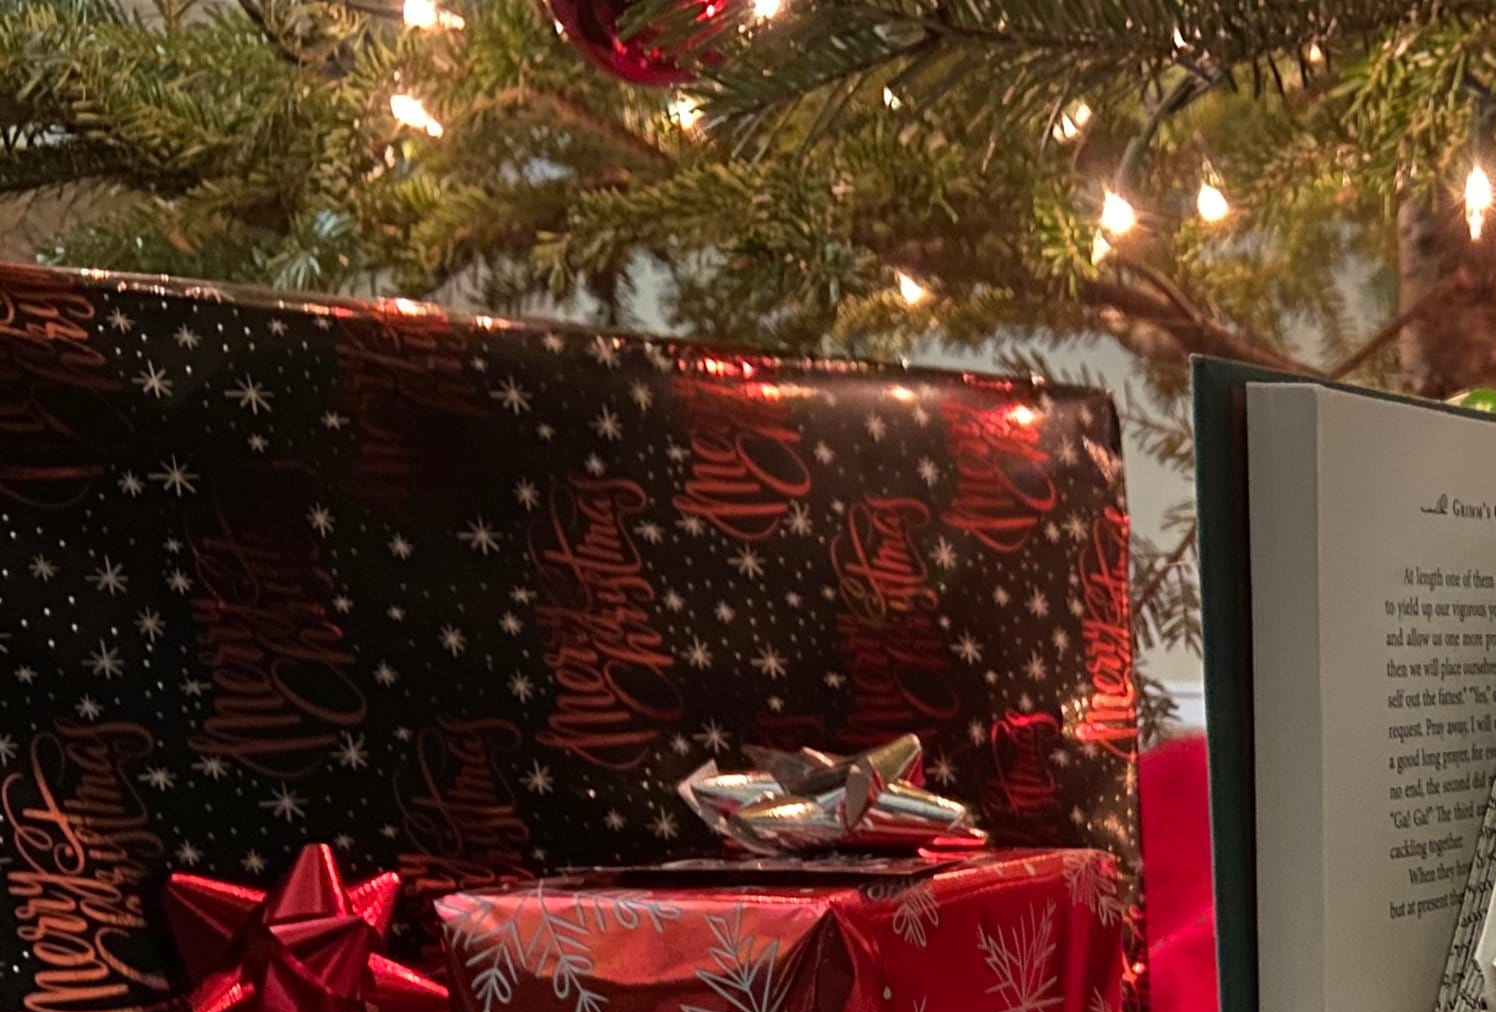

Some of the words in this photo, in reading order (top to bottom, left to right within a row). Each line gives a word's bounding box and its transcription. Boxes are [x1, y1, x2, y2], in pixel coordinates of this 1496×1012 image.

[1416, 566, 1443, 591] length
[1473, 569, 1495, 589] them
[1385, 600, 1396, 616] to
[1397, 597, 1419, 621] yield
[1421, 603, 1433, 621] up
[1435, 603, 1450, 616] our
[1386, 627, 1404, 647] and
[1406, 627, 1429, 647] allow
[1432, 633, 1443, 646] us
[1444, 633, 1460, 646] one
[1462, 633, 1483, 647] more
[1386, 659, 1408, 678] then
[1409, 664, 1422, 677] we
[1422, 657, 1439, 676] will
[1440, 658, 1462, 681] place
[1388, 689, 1404, 709] self
[1405, 692, 1421, 708] out
[1422, 689, 1436, 707] the
[1389, 756, 1395, 770] a
[1396, 748, 1420, 775] good
[1421, 748, 1441, 771] long
[1390, 786, 1402, 800] no
[1426, 776, 1441, 796] the
[1442, 773, 1471, 793] second
[1390, 839, 1427, 861] cackling
[1409, 865, 1437, 884] When
[1437, 863, 1456, 882] they
[1390, 901, 1405, 919] but
[1406, 901, 1417, 916] at
